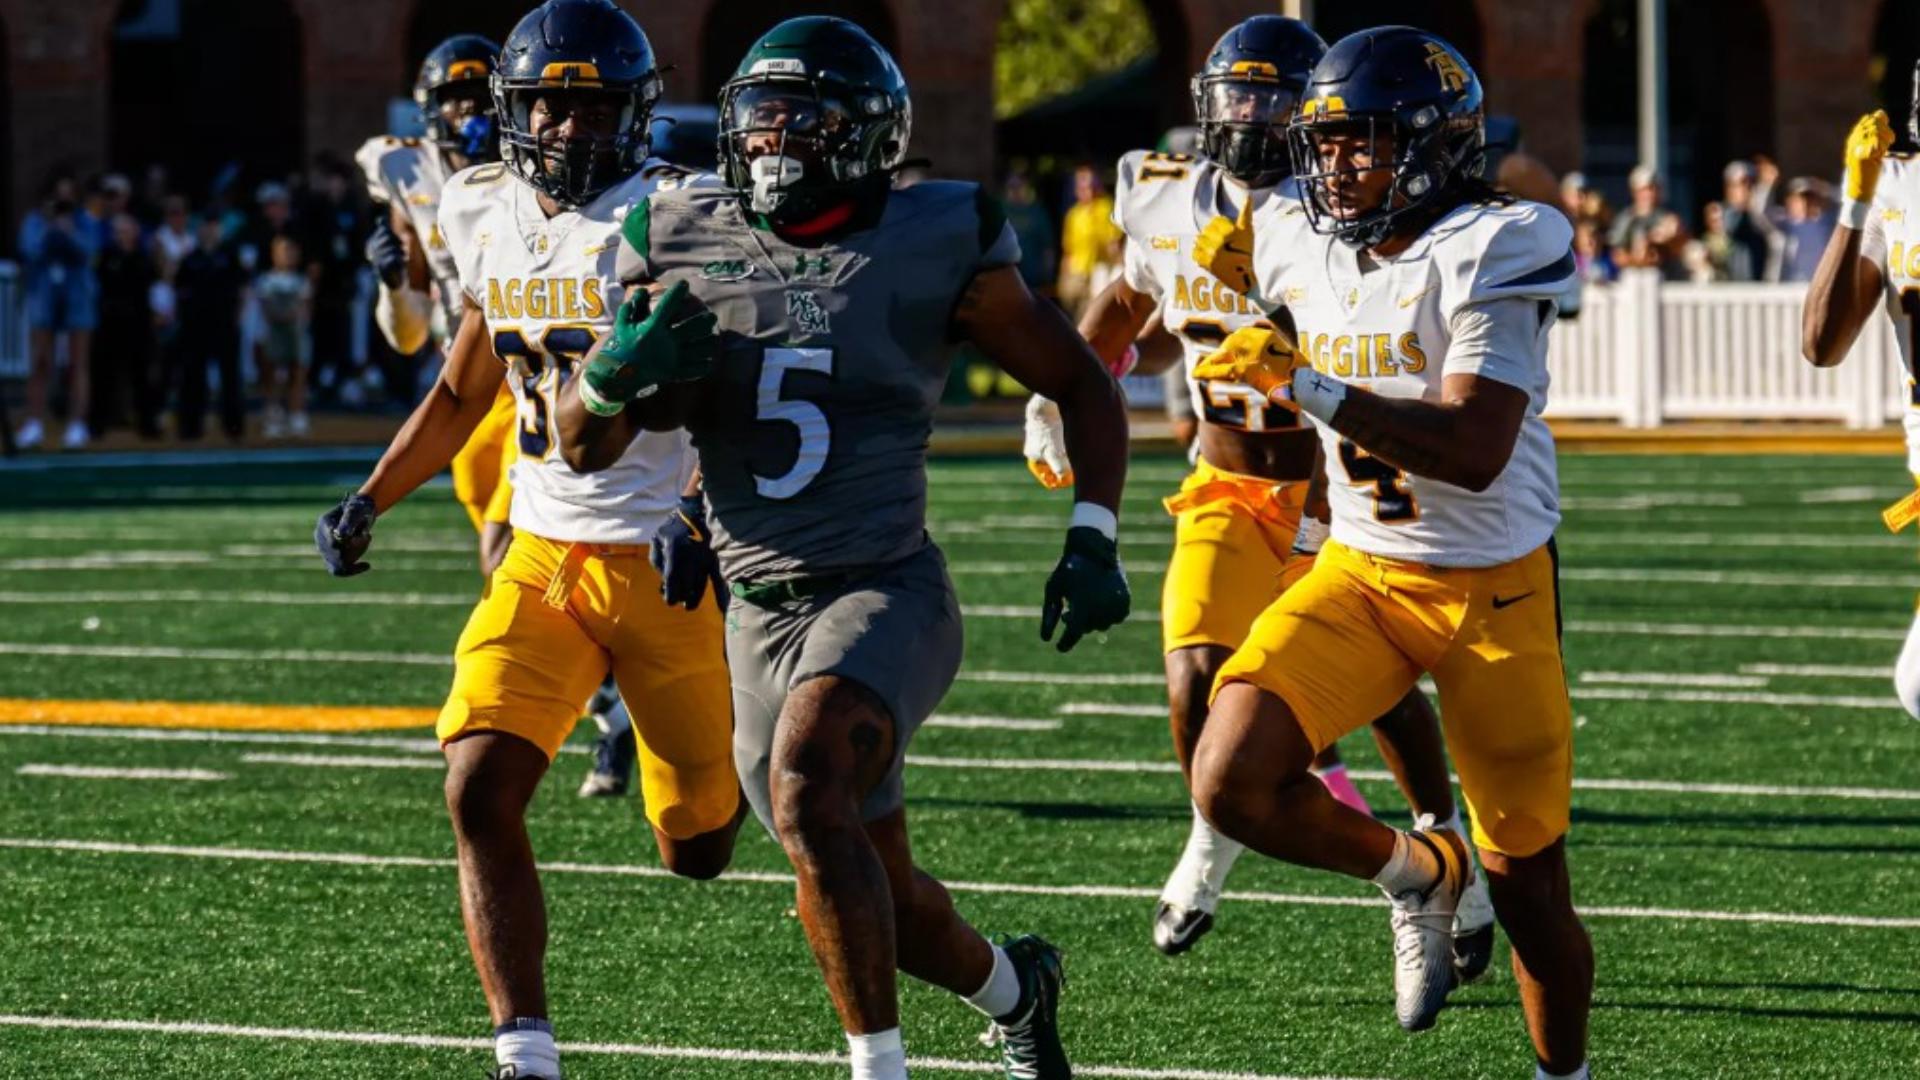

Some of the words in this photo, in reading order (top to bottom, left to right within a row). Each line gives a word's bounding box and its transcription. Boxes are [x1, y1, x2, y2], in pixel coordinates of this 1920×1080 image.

[487, 278, 604, 319] AGGIES
[1174, 274, 1260, 315] AGGI
[757, 348, 833, 499] 5
